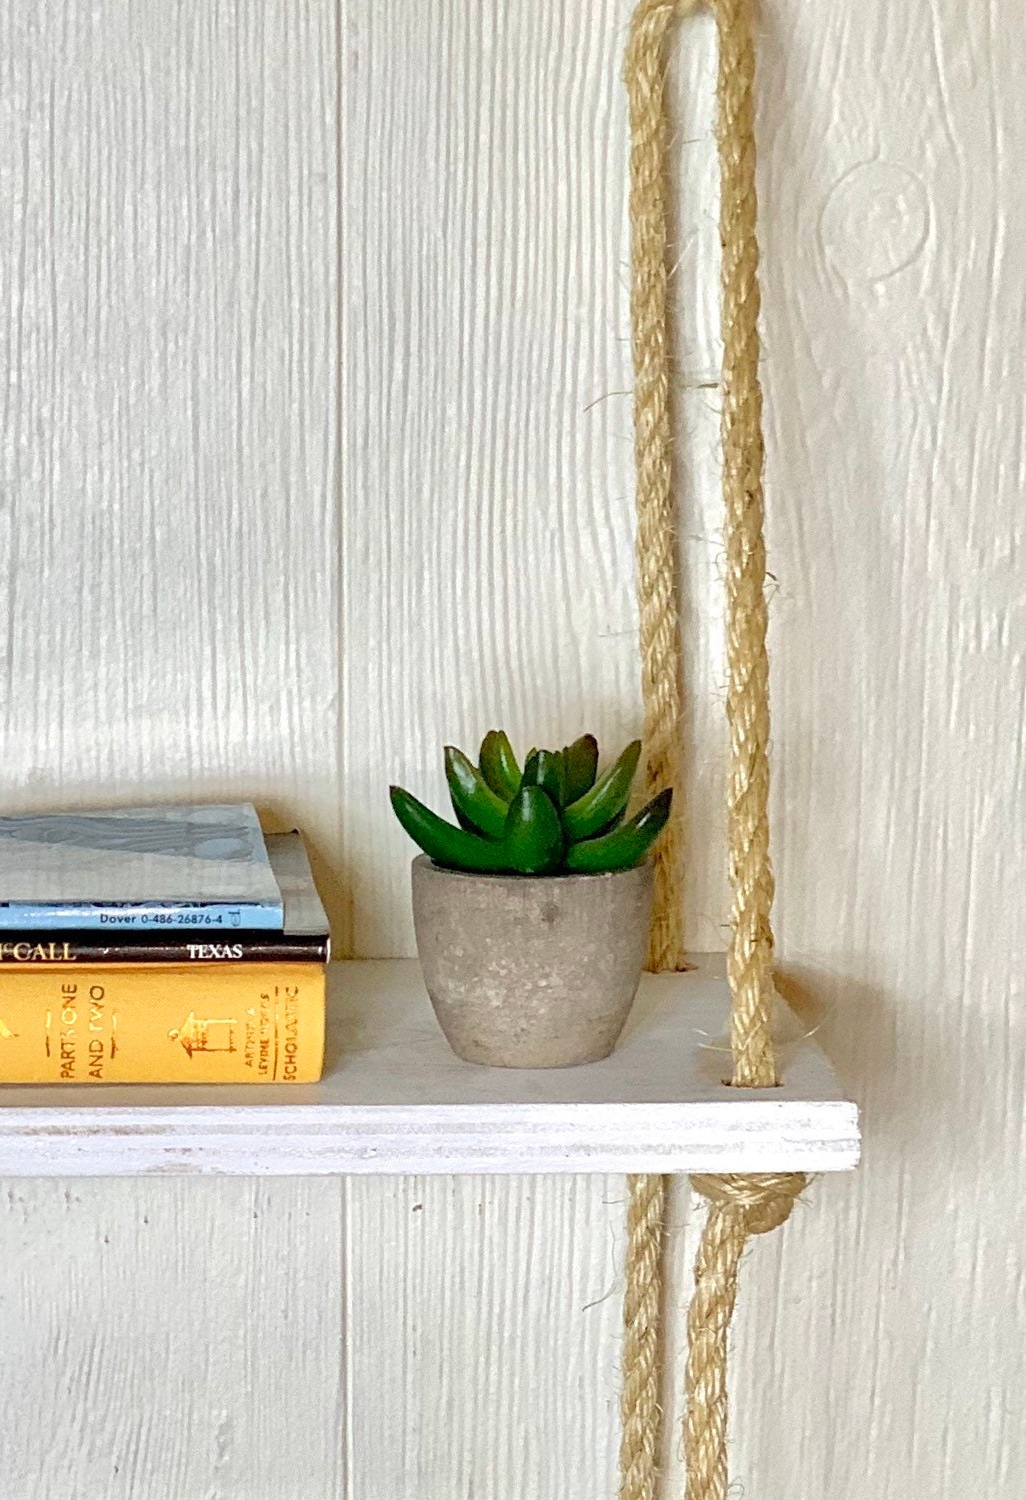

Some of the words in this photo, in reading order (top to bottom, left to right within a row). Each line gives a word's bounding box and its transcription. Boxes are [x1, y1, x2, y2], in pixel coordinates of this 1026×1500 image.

[100, 913, 136, 924] Dover
[141, 913, 223, 924] 0-486-26876-4
[186, 944, 243, 959] TEXAS
[61, 984, 77, 1025] ONE
[89, 985, 105, 1031] TWO
[60, 1029, 76, 1079] PARTS
[89, 1039, 103, 1079] AND
